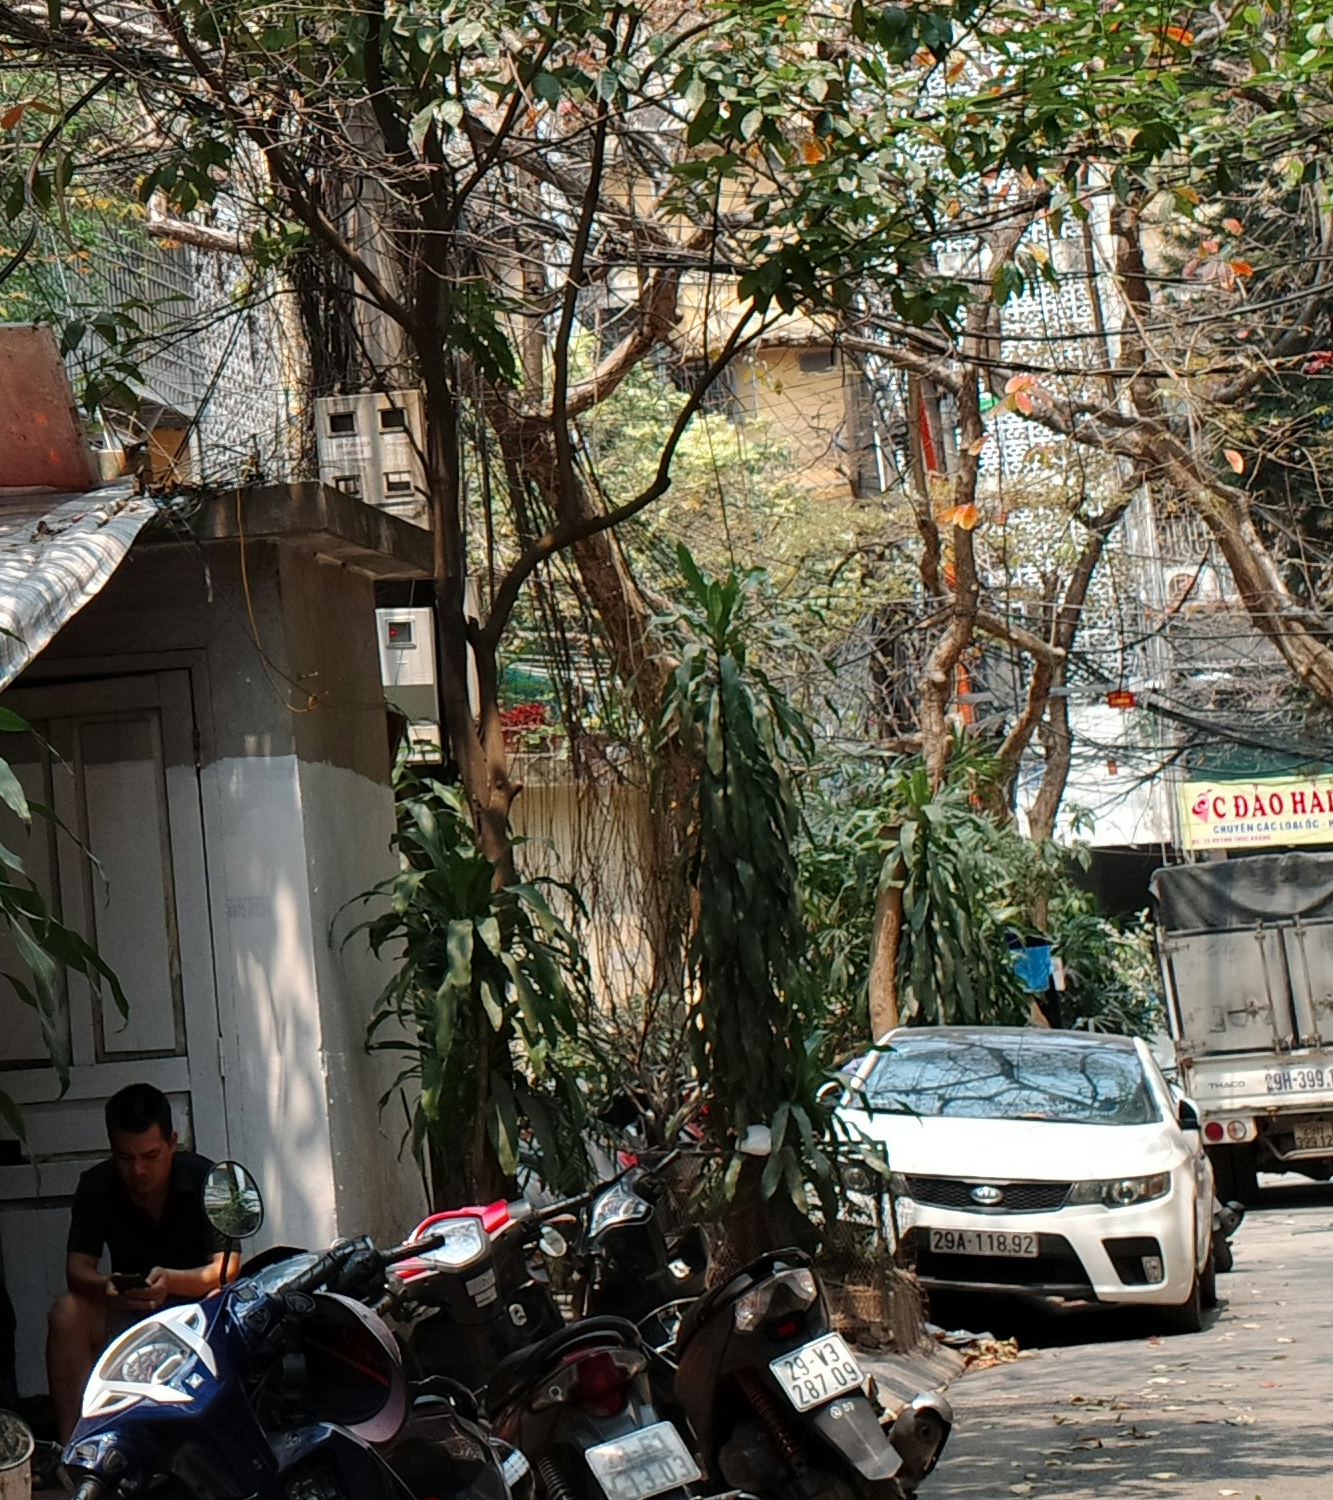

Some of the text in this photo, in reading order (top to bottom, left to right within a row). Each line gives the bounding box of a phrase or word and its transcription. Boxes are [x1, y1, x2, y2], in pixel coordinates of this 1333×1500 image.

[1232, 783, 1284, 818] ĐẢO
[933, 1231, 1034, 1254] 29A-118.92
[792, 1361, 858, 1405] 287.09
